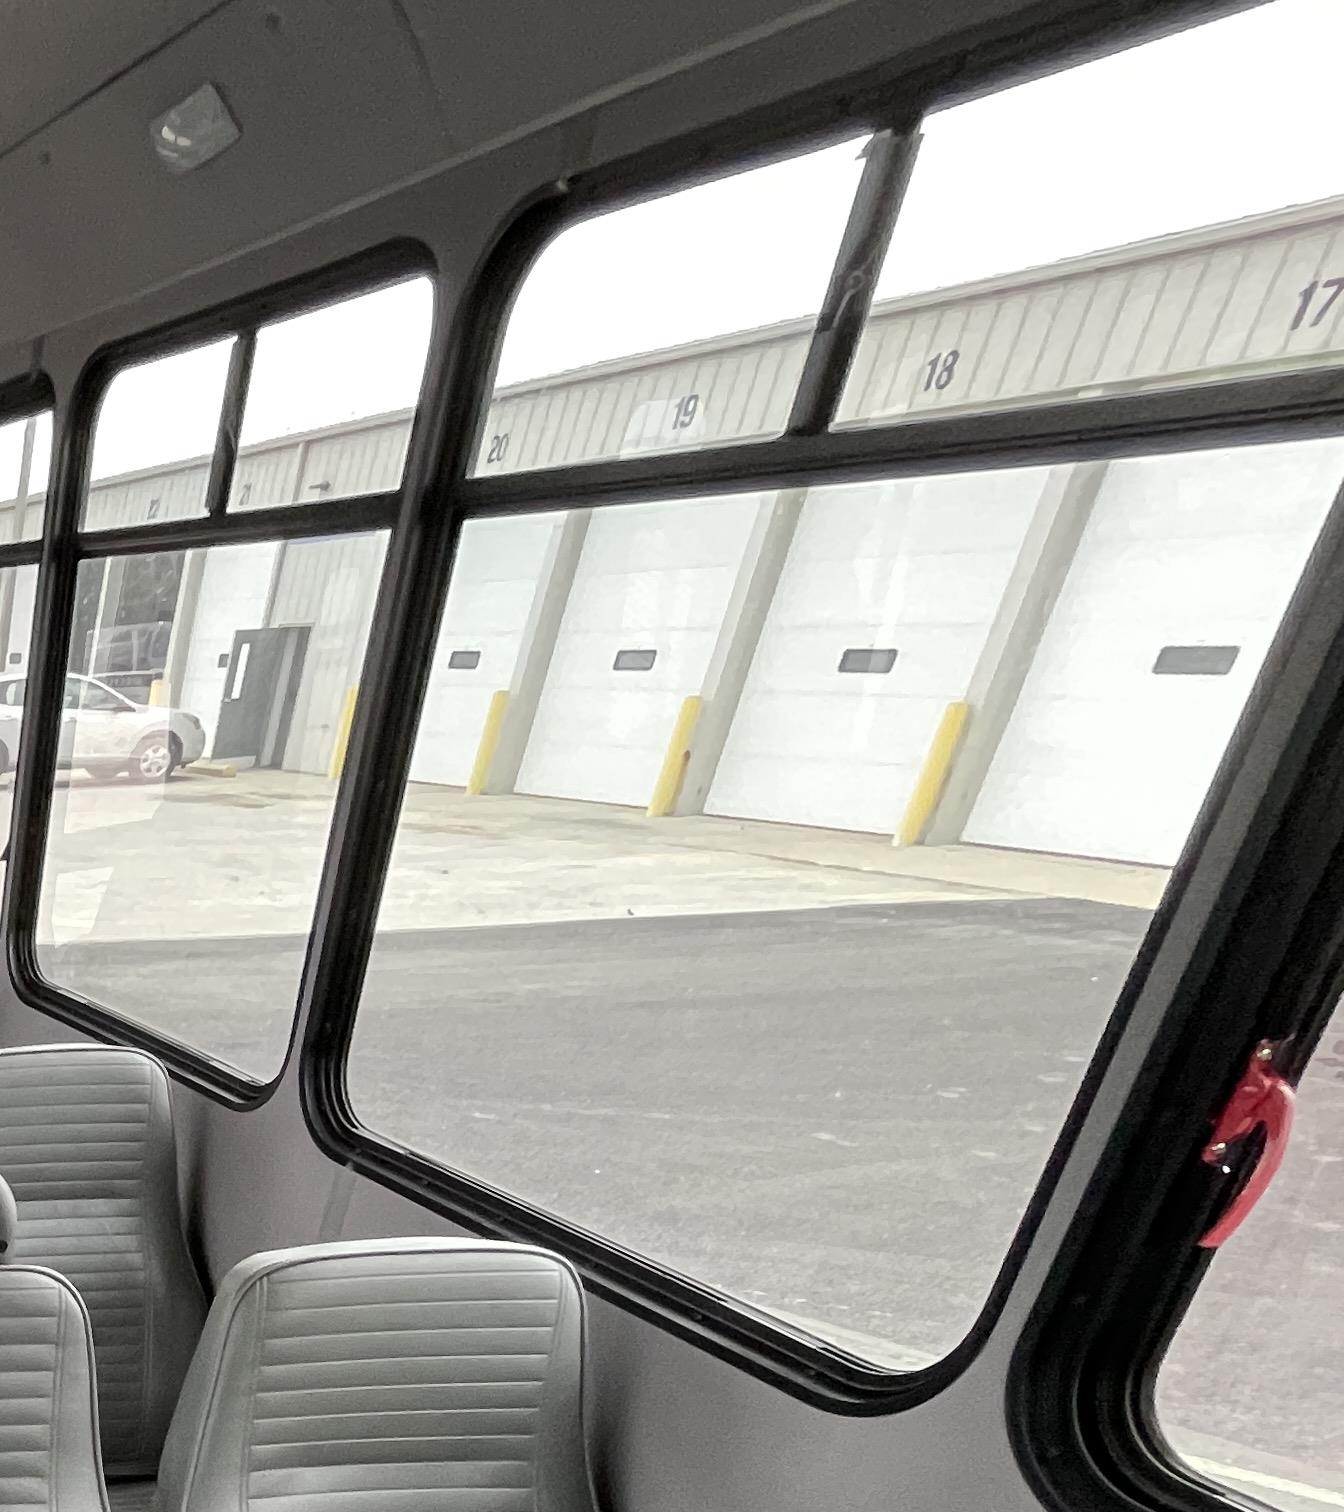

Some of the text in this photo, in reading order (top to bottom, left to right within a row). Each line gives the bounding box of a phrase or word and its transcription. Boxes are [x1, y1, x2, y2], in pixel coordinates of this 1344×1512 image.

[1289, 276, 1344, 331] 17
[924, 349, 961, 393] 18
[672, 393, 700, 431] 19
[487, 432, 510, 464] 20
